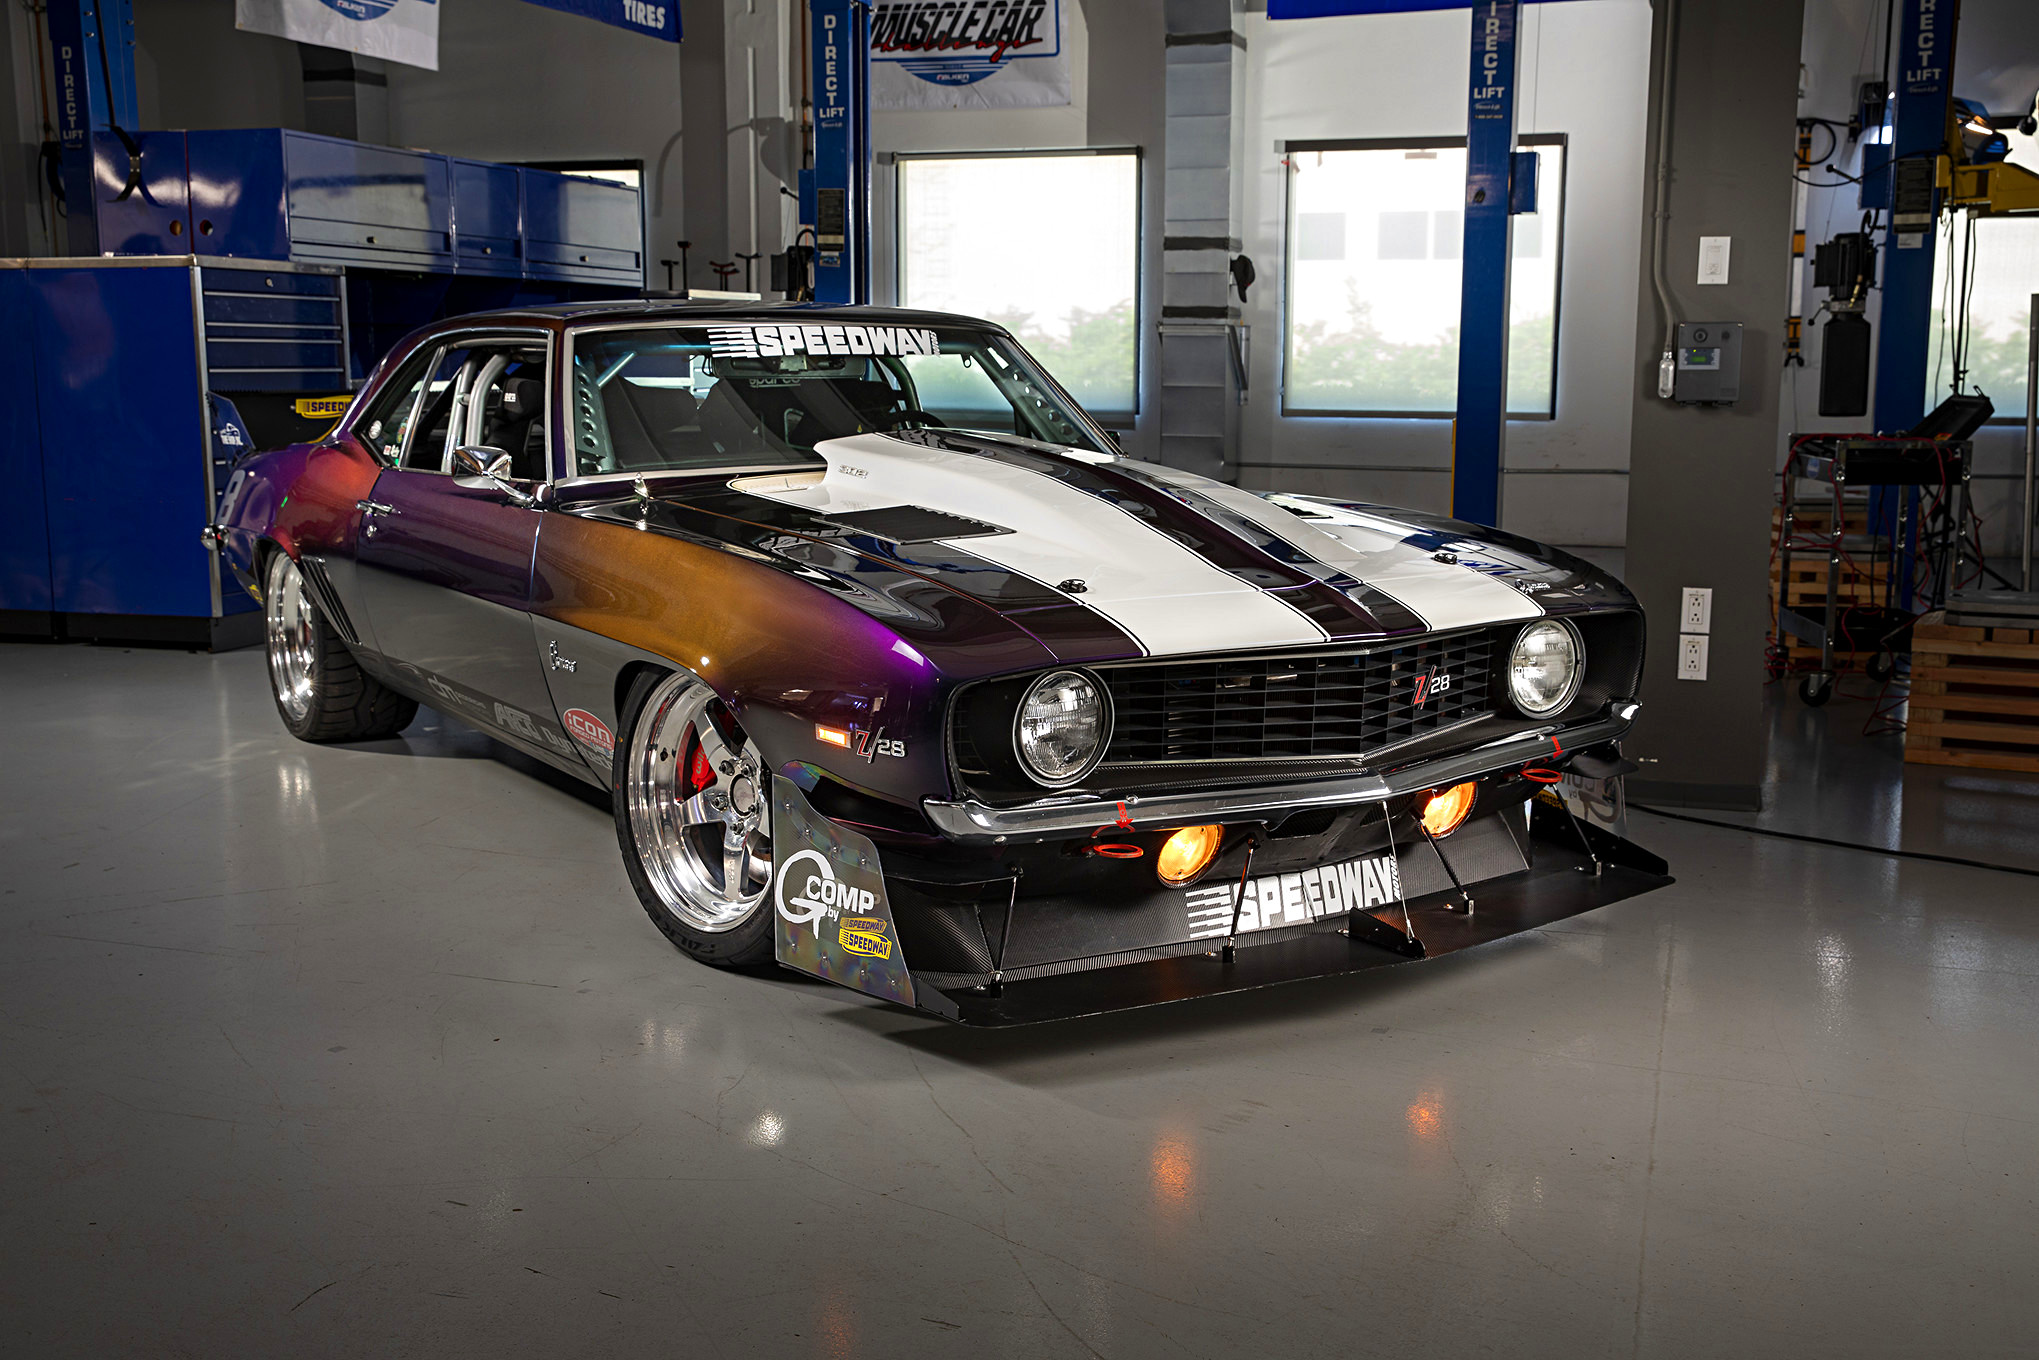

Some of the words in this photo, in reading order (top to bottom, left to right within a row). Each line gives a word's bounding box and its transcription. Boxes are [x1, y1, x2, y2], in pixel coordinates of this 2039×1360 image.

[623, 0, 666, 30] TIRES
[1483, 1, 1500, 86] IRECT
[1917, 0, 1936, 67] RECT
[824, 14, 838, 106] DIRECT
[1906, 68, 1943, 82] LIFT
[61, 46, 77, 129] DIRECT
[1473, 87, 1505, 99] LIFT
[819, 107, 845, 118] LIFT
[63, 130, 84, 140] LIFT
[755, 326, 932, 357] SPEEDWAY
[311, 402, 350, 412] SPEED
[1411, 665, 1450, 710] Z/28
[855, 726, 905, 763] Z/28
[806, 875, 875, 915] COMP
[1233, 856, 1391, 932] SPEEDWAY
[827, 906, 840, 922] by
[848, 933, 888, 956] SPEEDWAY
